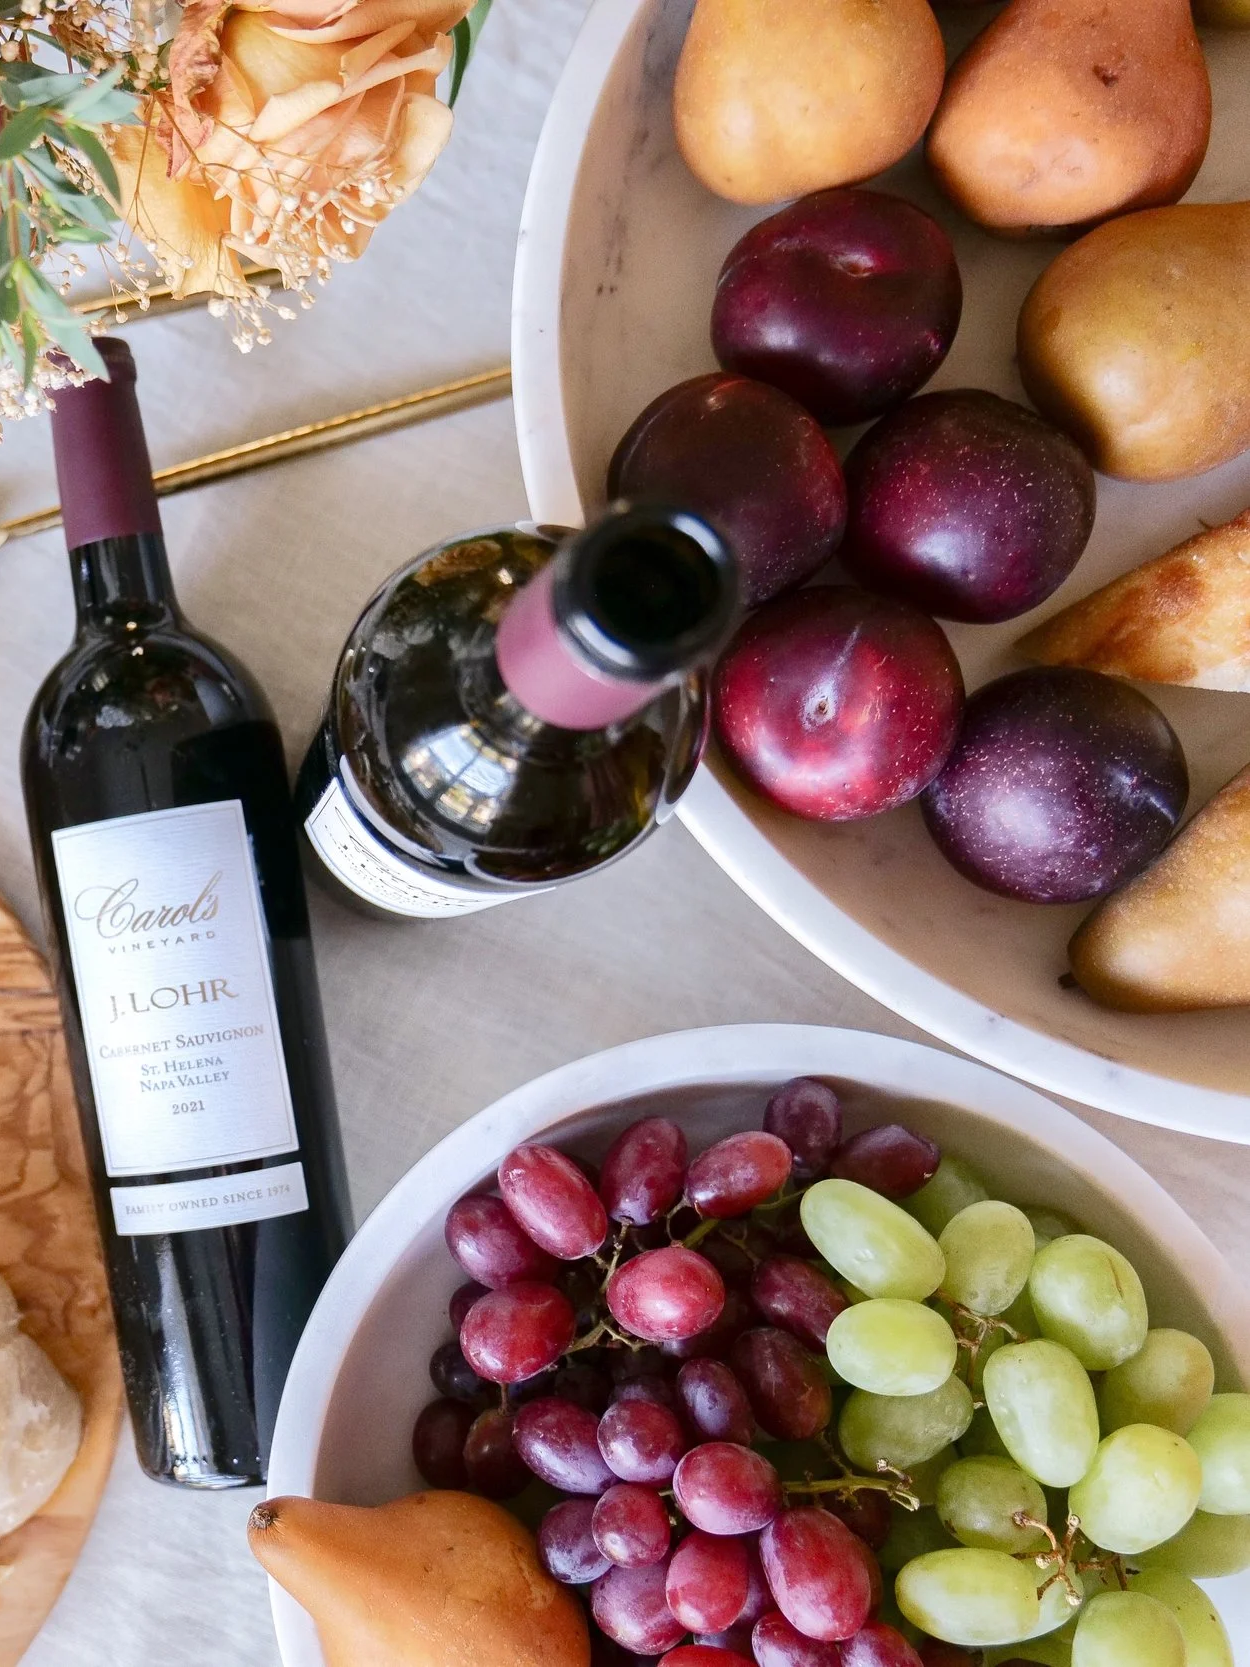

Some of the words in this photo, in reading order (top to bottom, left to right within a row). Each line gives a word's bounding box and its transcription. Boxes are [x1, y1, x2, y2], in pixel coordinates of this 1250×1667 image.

[73, 870, 225, 939] Carol's
[108, 930, 216, 954] VINEYARD
[109, 995, 126, 1023] J.
[128, 978, 239, 1014] LOHR
[98, 1039, 170, 1060] CABERNET
[175, 1024, 265, 1049] SAUVIGNON
[164, 1056, 223, 1073] HELENA
[140, 1079, 176, 1092] NAPA
[178, 1071, 230, 1088] VALLEY
[172, 1100, 206, 1115] 2021
[169, 1197, 219, 1211] OWNED
[222, 1189, 264, 1205] SINCE
[267, 1183, 291, 1198] 1974
